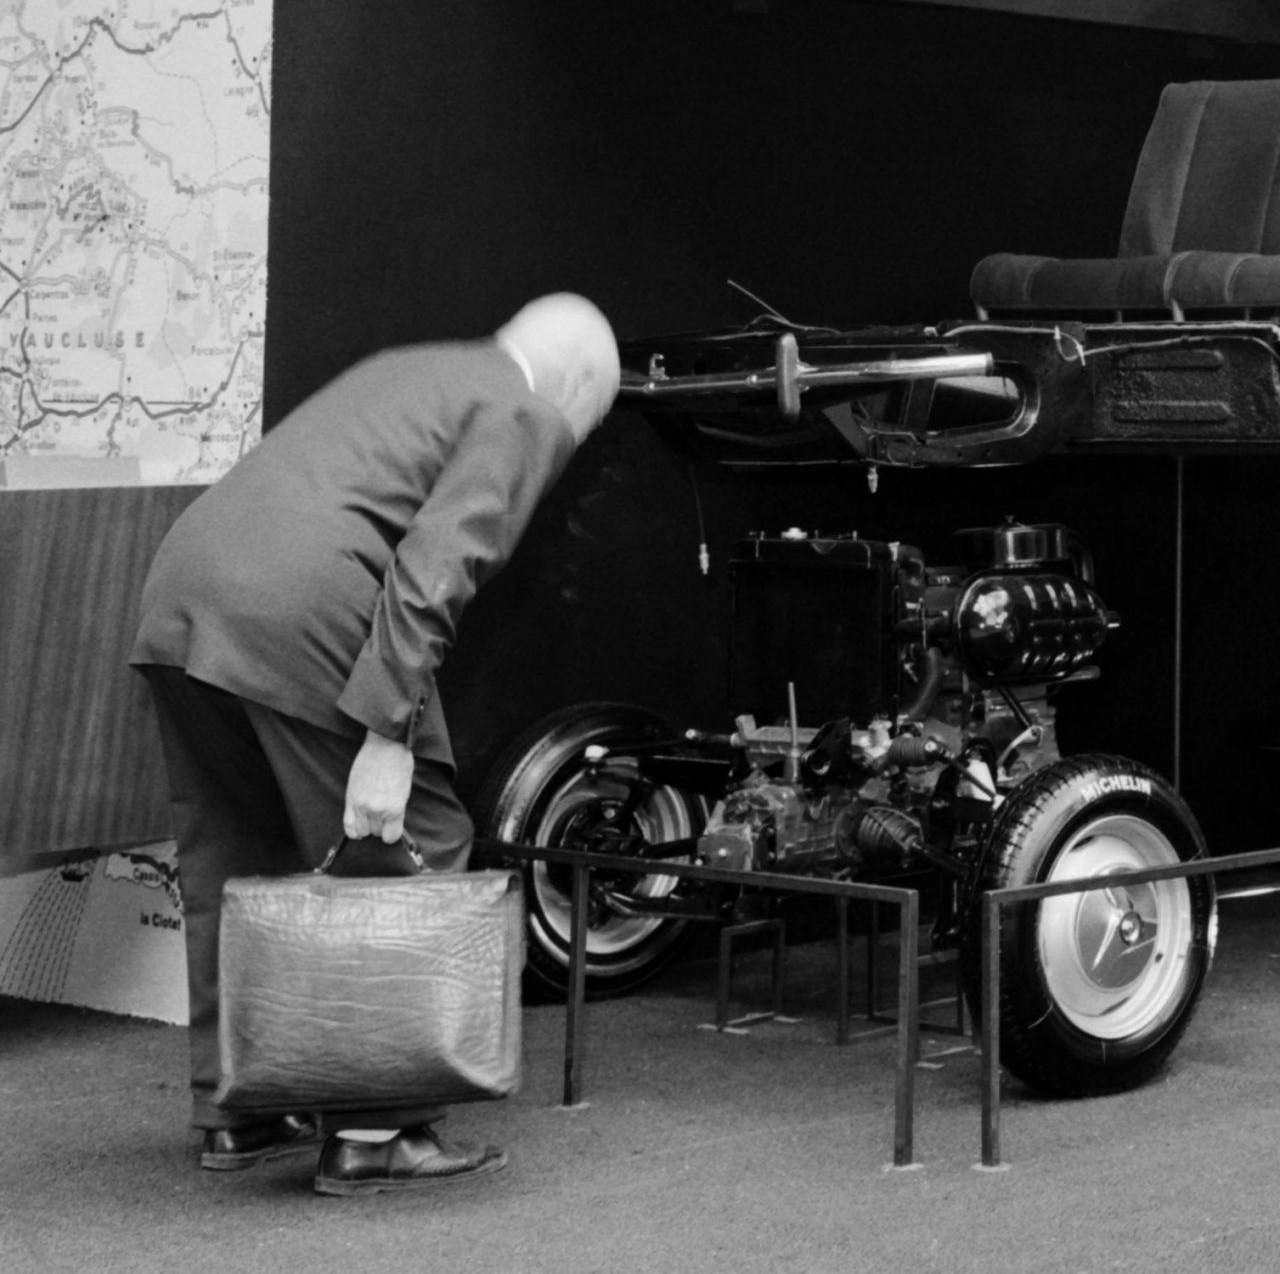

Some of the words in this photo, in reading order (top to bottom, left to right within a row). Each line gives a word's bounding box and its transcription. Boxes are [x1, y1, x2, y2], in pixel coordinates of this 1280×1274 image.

[10, 331, 145, 349] VAUCLUSE
[1080, 774, 1151, 803] MICHELIN
[152, 913, 181, 931] Ciotat
